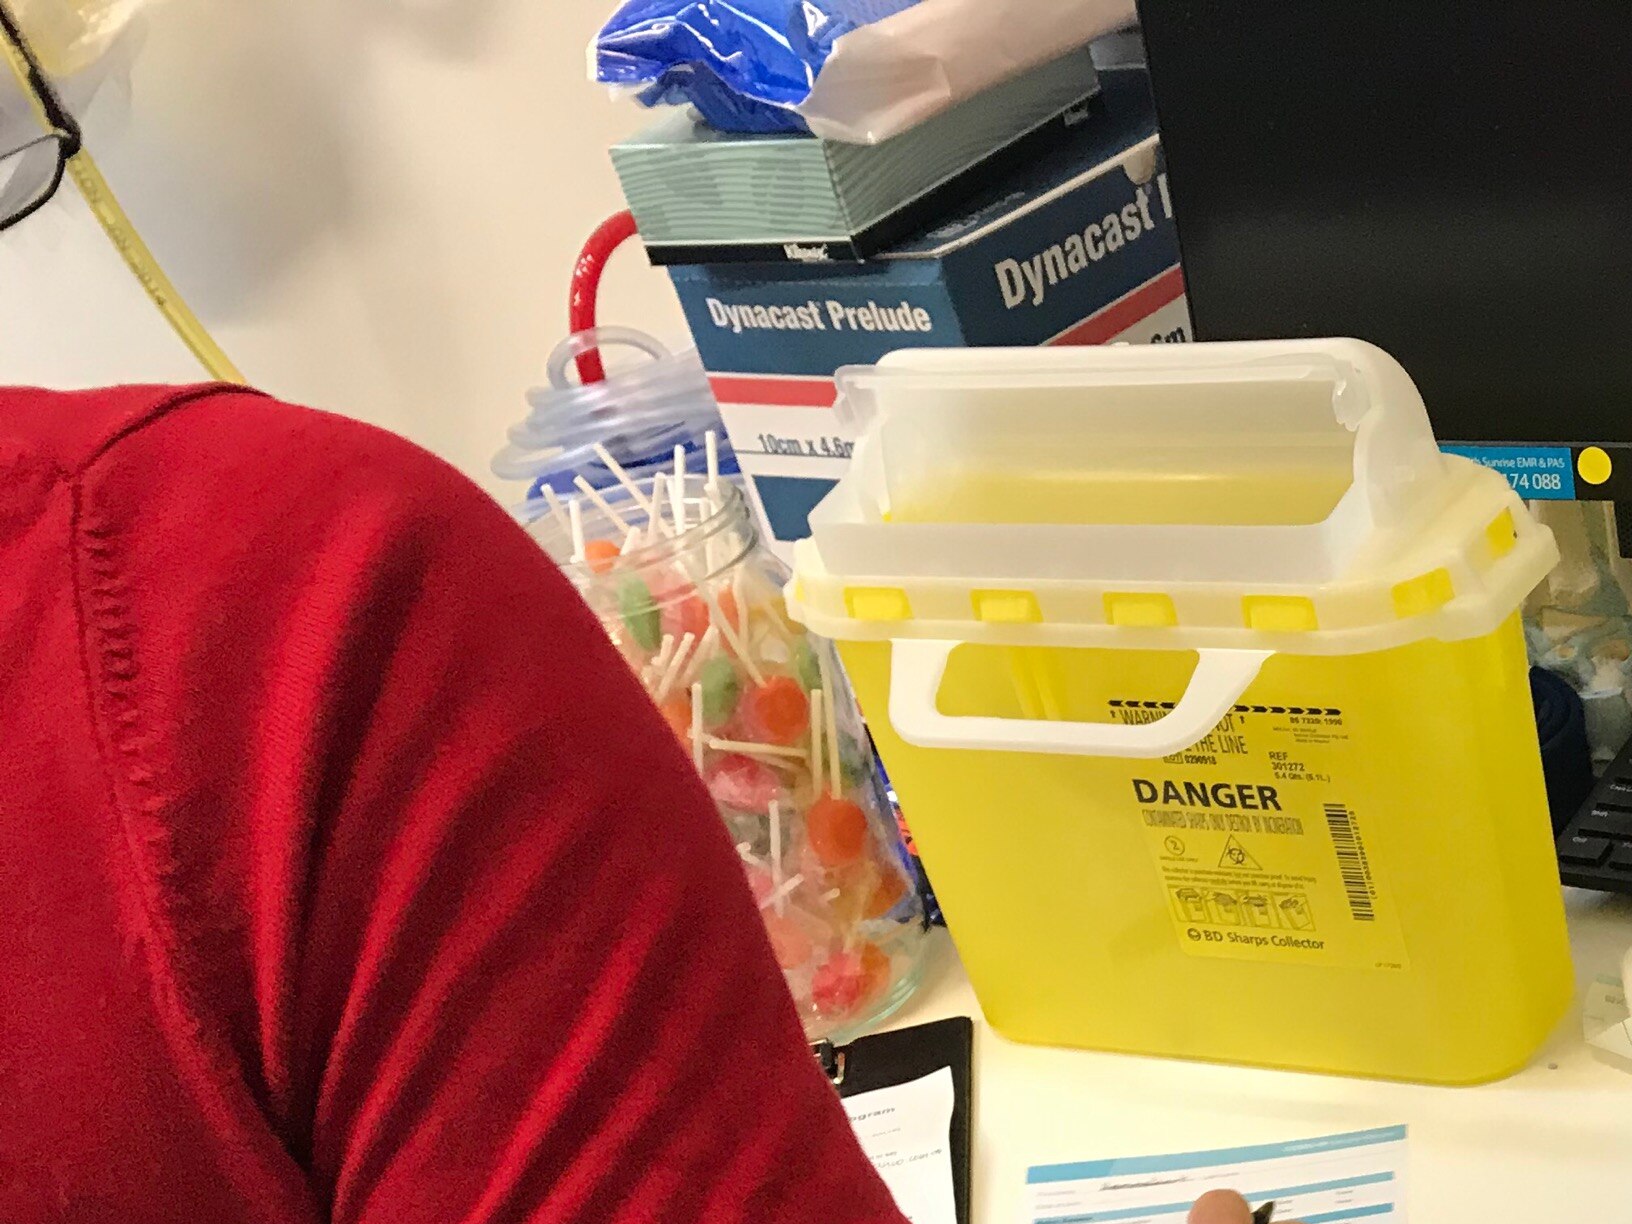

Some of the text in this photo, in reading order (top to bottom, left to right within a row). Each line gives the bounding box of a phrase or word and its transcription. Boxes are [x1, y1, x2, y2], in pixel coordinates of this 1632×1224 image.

[995, 187, 1155, 309] Dynacast
[705, 298, 932, 334] Dynacast Prelude
[1517, 457, 1537, 469] EMR
[1547, 457, 1565, 469] PAS
[1532, 474, 1561, 490] 088
[1219, 735, 1248, 754] LINE
[1269, 752, 1288, 761] REF
[1132, 778, 1282, 811] DANGER
[1203, 930, 1325, 950] BD Sharps Collector
